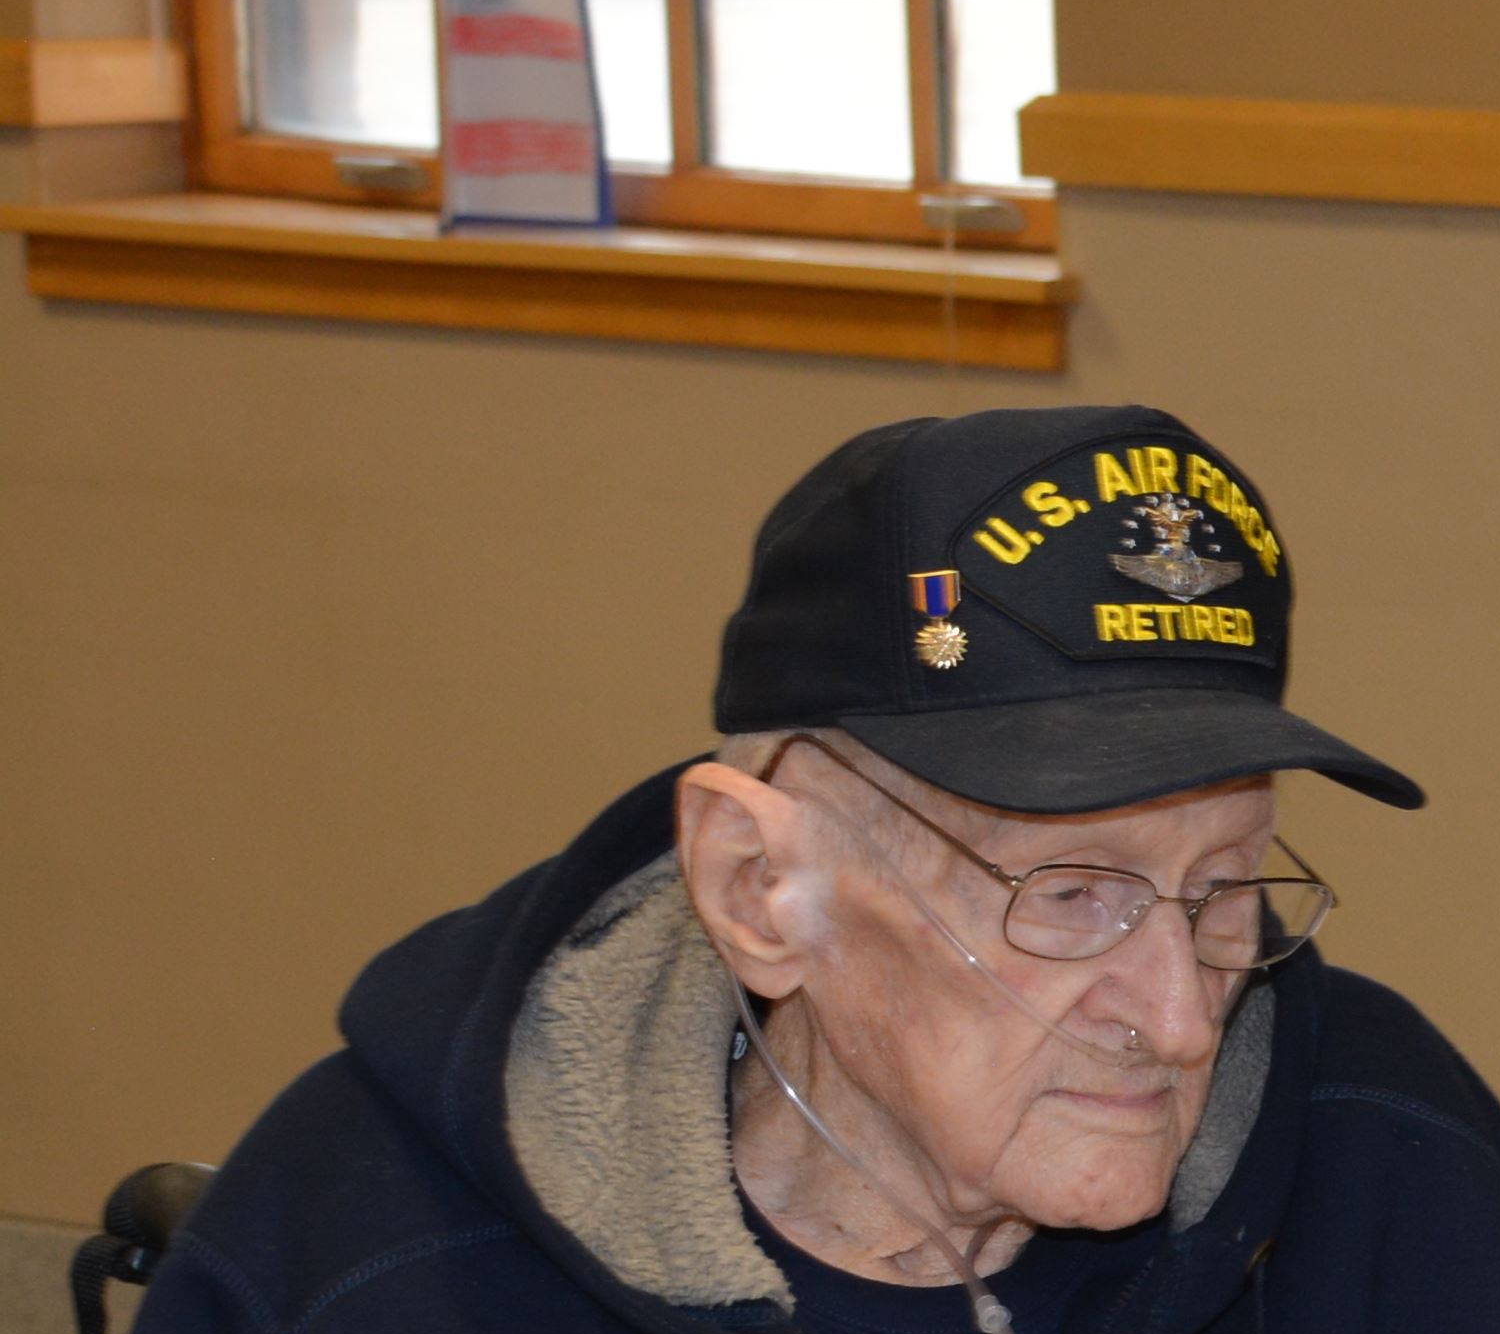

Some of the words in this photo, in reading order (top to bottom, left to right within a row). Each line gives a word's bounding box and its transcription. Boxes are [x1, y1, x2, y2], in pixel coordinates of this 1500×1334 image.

[972, 481, 1092, 565] U.S.
[1093, 446, 1180, 504] AIR
[1093, 604, 1255, 647] RETIRED
